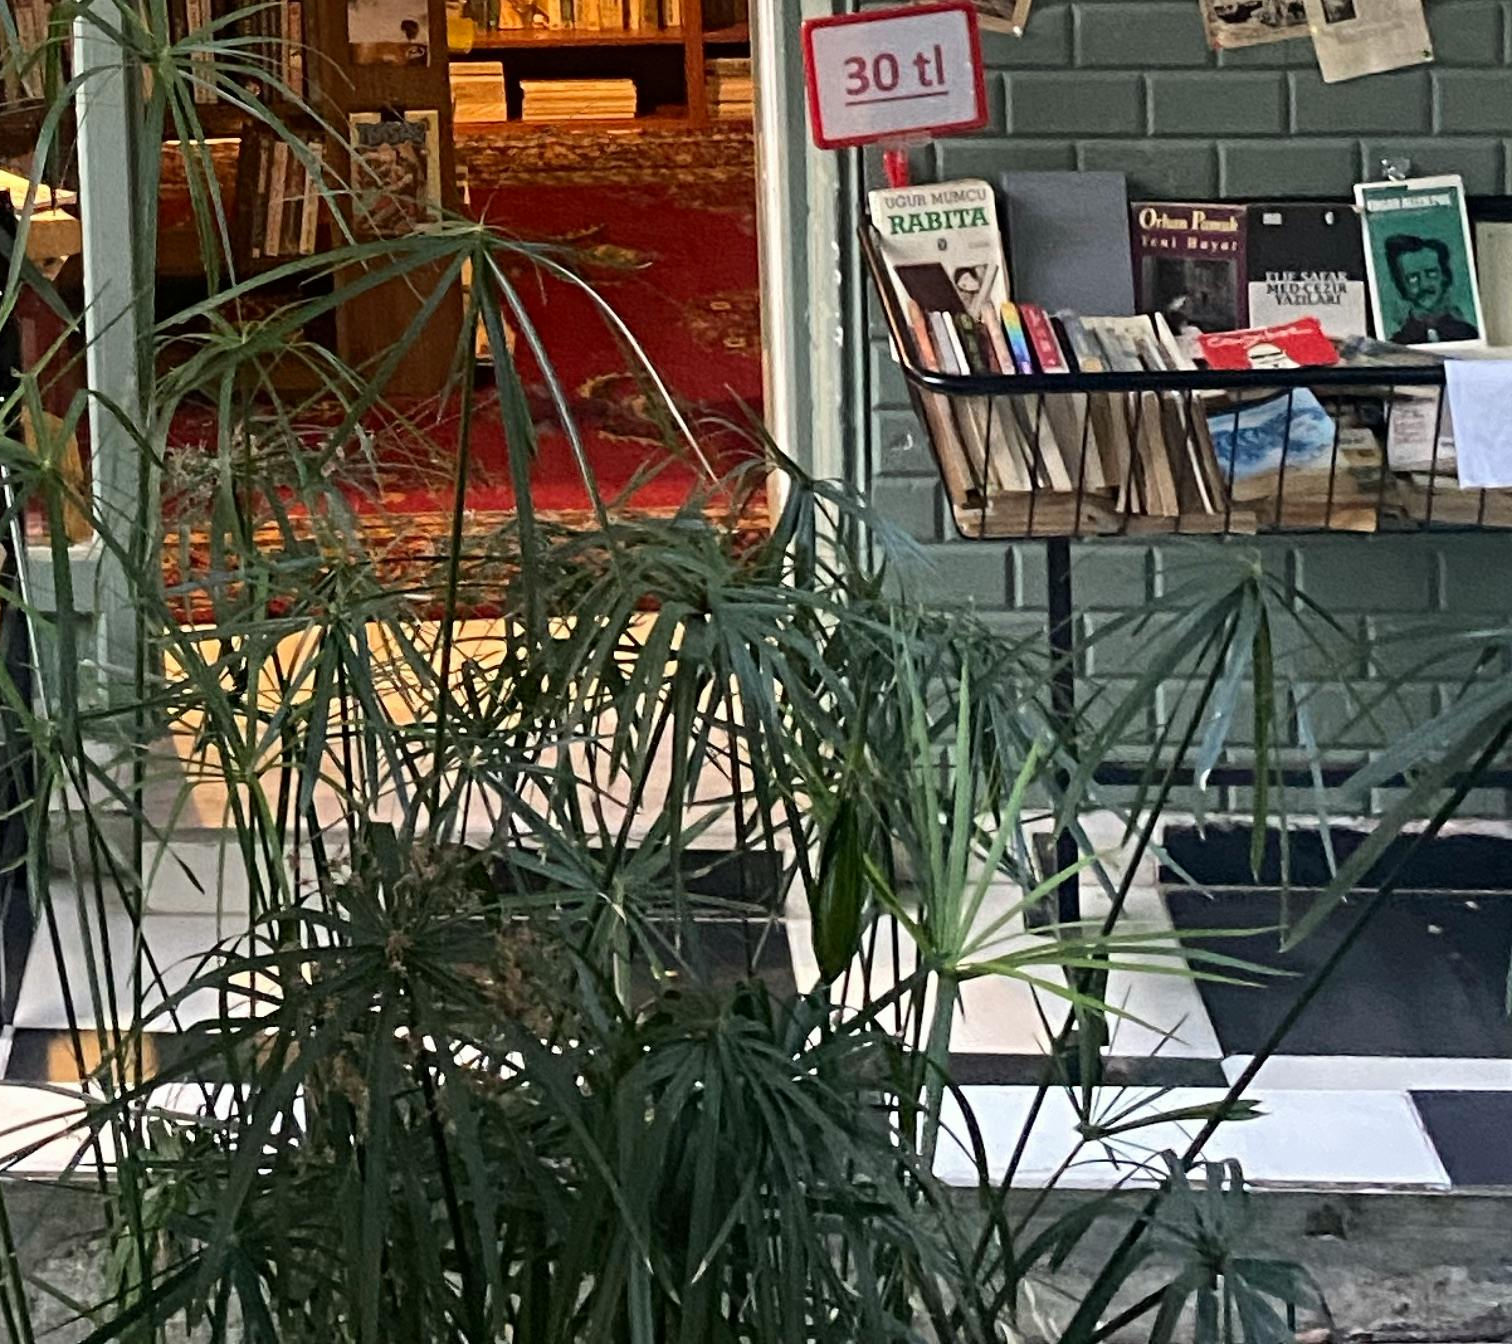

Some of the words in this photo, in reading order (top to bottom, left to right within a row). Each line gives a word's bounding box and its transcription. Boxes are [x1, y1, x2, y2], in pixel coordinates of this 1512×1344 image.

[843, 51, 900, 97] 30
[911, 44, 946, 88] tl
[931, 188, 987, 205] MUMCU
[887, 206, 990, 235] RABITA
